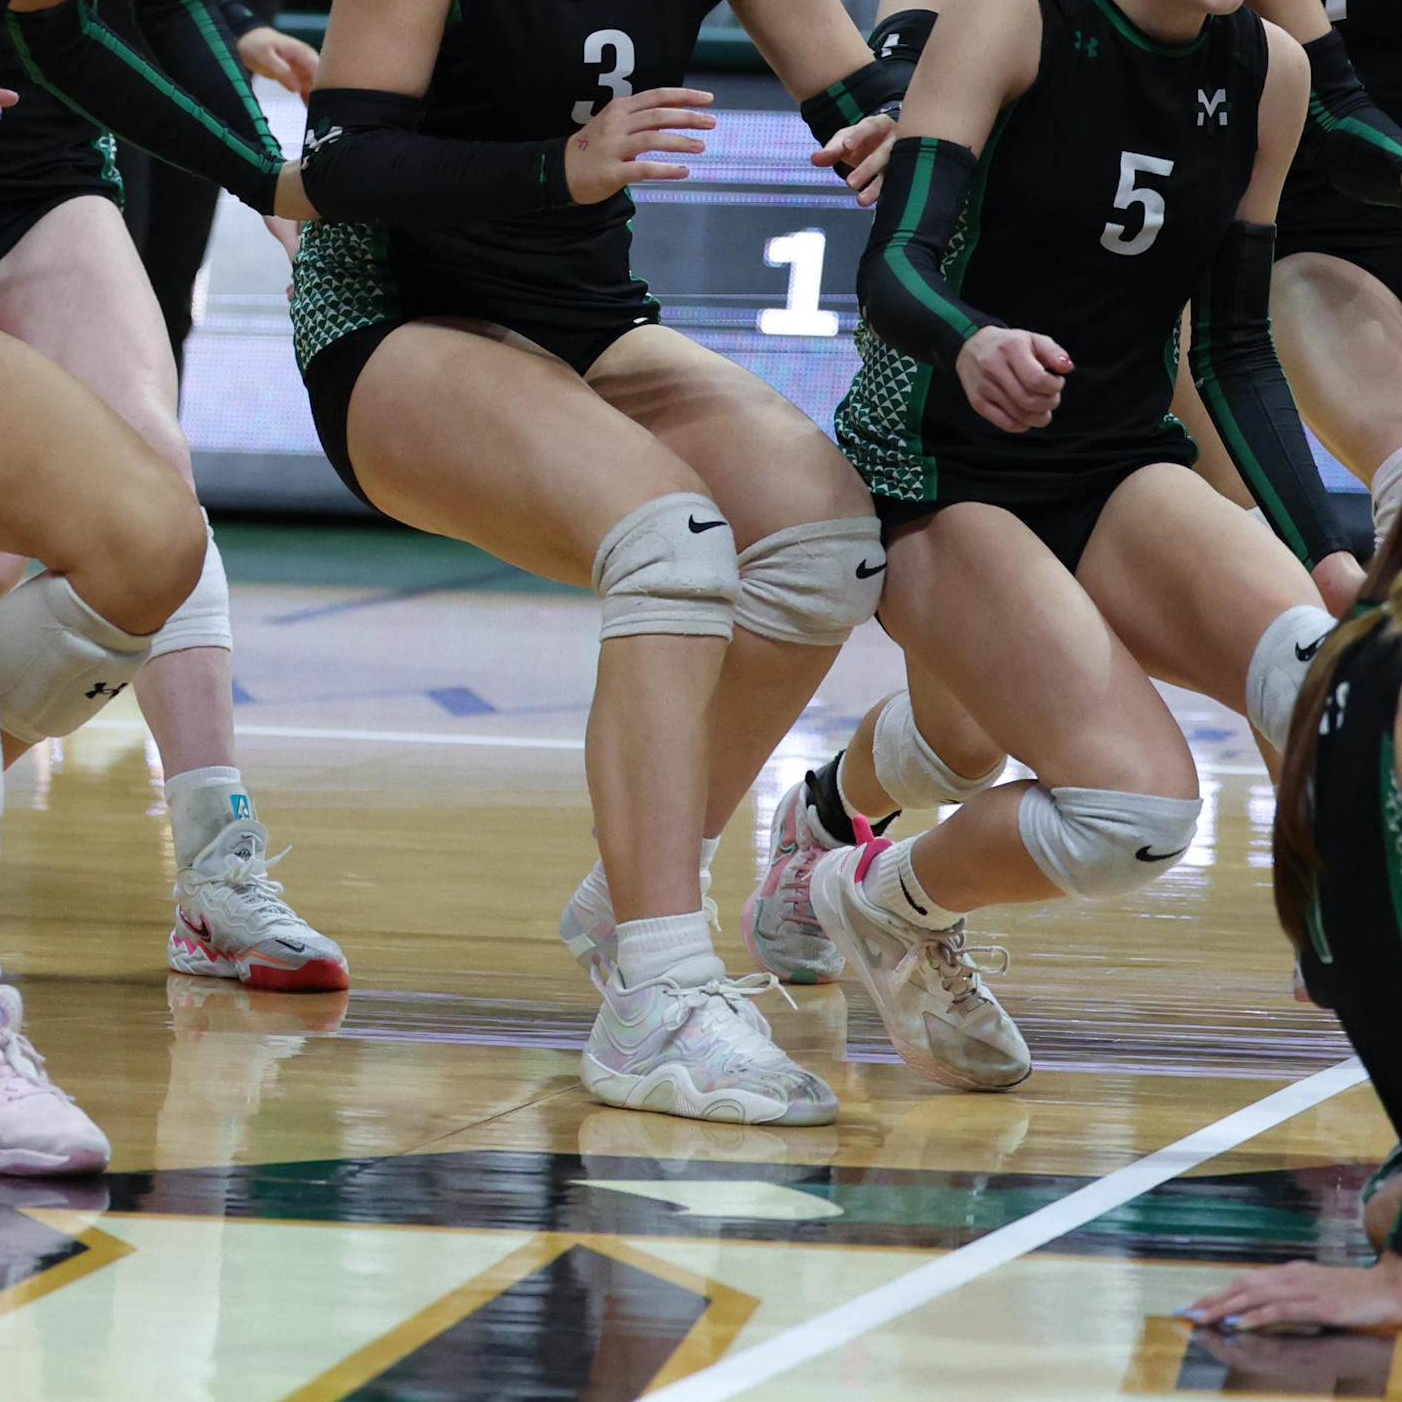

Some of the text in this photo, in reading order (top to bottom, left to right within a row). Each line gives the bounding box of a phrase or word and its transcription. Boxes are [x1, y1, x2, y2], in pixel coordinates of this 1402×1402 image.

[570, 28, 636, 125] 3
[1196, 88, 1228, 127] M
[1100, 150, 1175, 257] 5
[756, 228, 839, 337] 1
